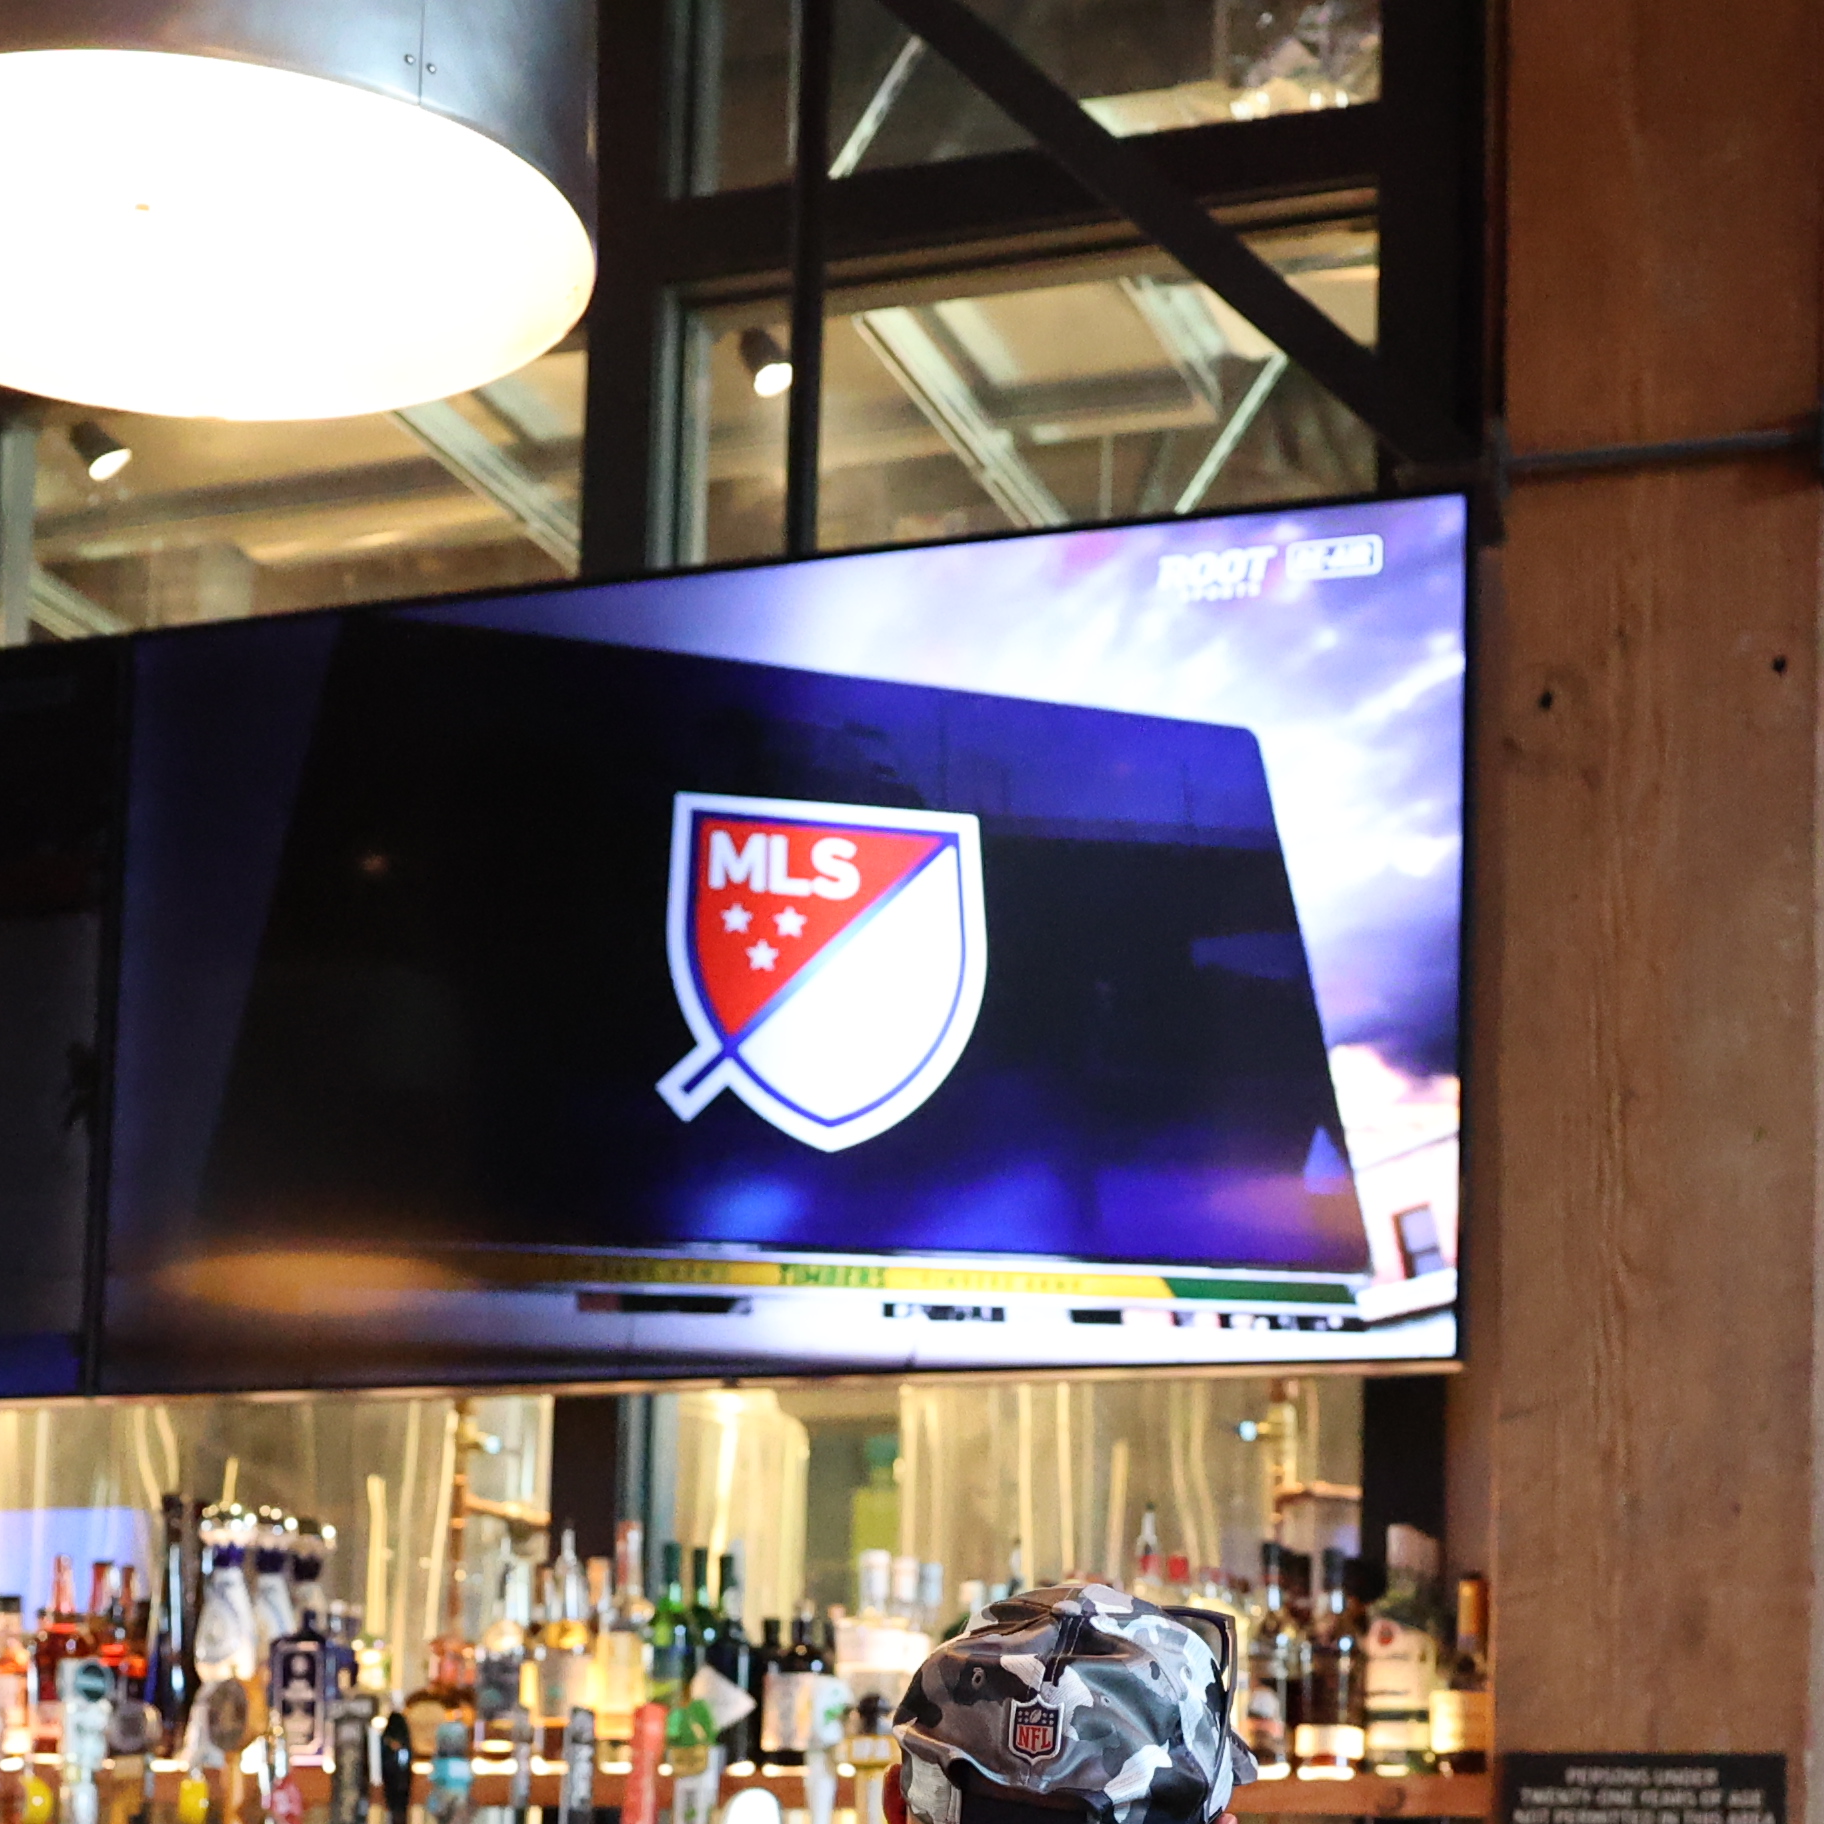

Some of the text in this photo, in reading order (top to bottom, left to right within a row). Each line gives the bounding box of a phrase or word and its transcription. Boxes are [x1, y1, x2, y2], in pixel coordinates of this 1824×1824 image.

[1155, 545, 1279, 591] ROOT
[707, 829, 862, 901] MLS
[1017, 1725, 1052, 1751] NFL
[1565, 1766, 1718, 1786] PERSONS UNDER
[1639, 1788, 1697, 1808] YEARS
[1699, 1788, 1722, 1808] OF
[1728, 1789, 1763, 1809] AGE
